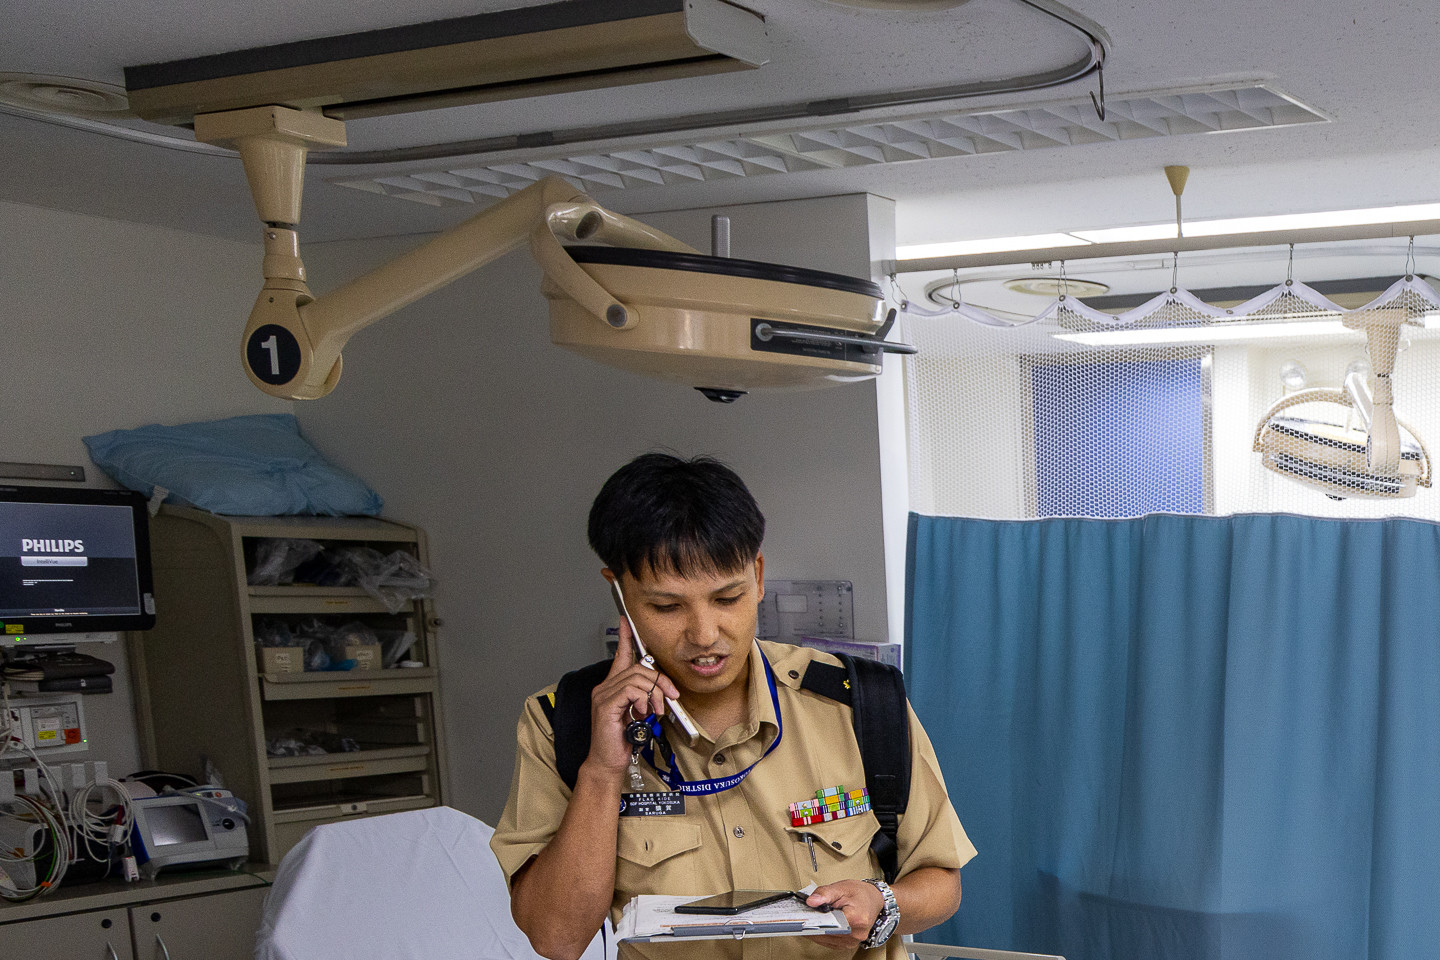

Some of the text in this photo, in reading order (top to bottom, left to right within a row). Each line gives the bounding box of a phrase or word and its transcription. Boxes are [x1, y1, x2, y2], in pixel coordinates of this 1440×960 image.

[261, 335, 280, 375] 1
[22, 539, 84, 552] PHILIPS
[677, 784, 711, 792] DISTRIC
